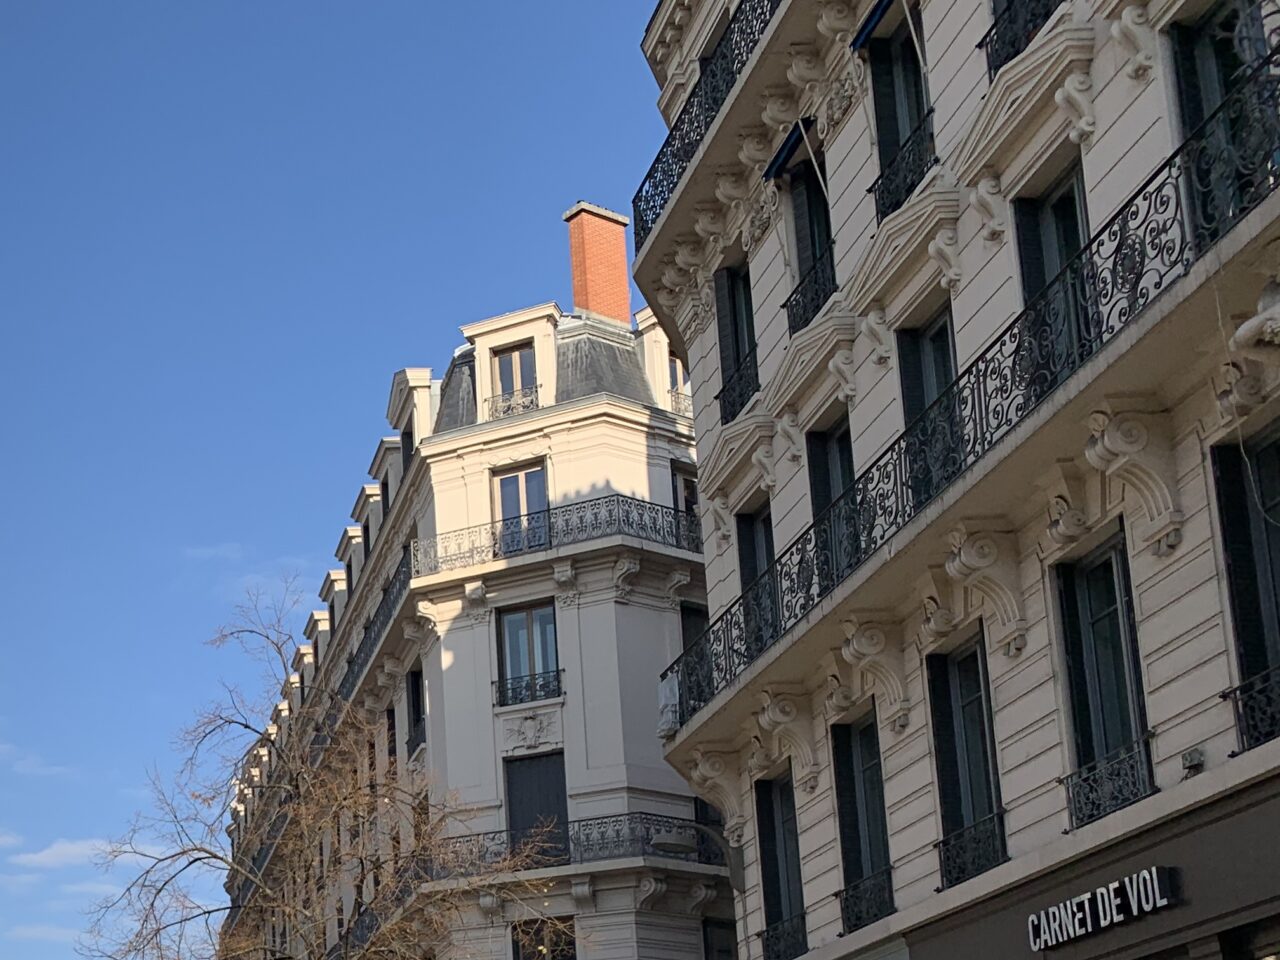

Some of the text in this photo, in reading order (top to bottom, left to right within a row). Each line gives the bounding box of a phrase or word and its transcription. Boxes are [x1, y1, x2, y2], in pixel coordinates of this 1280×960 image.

[1028, 866, 1168, 952] CARNET DE VOL
